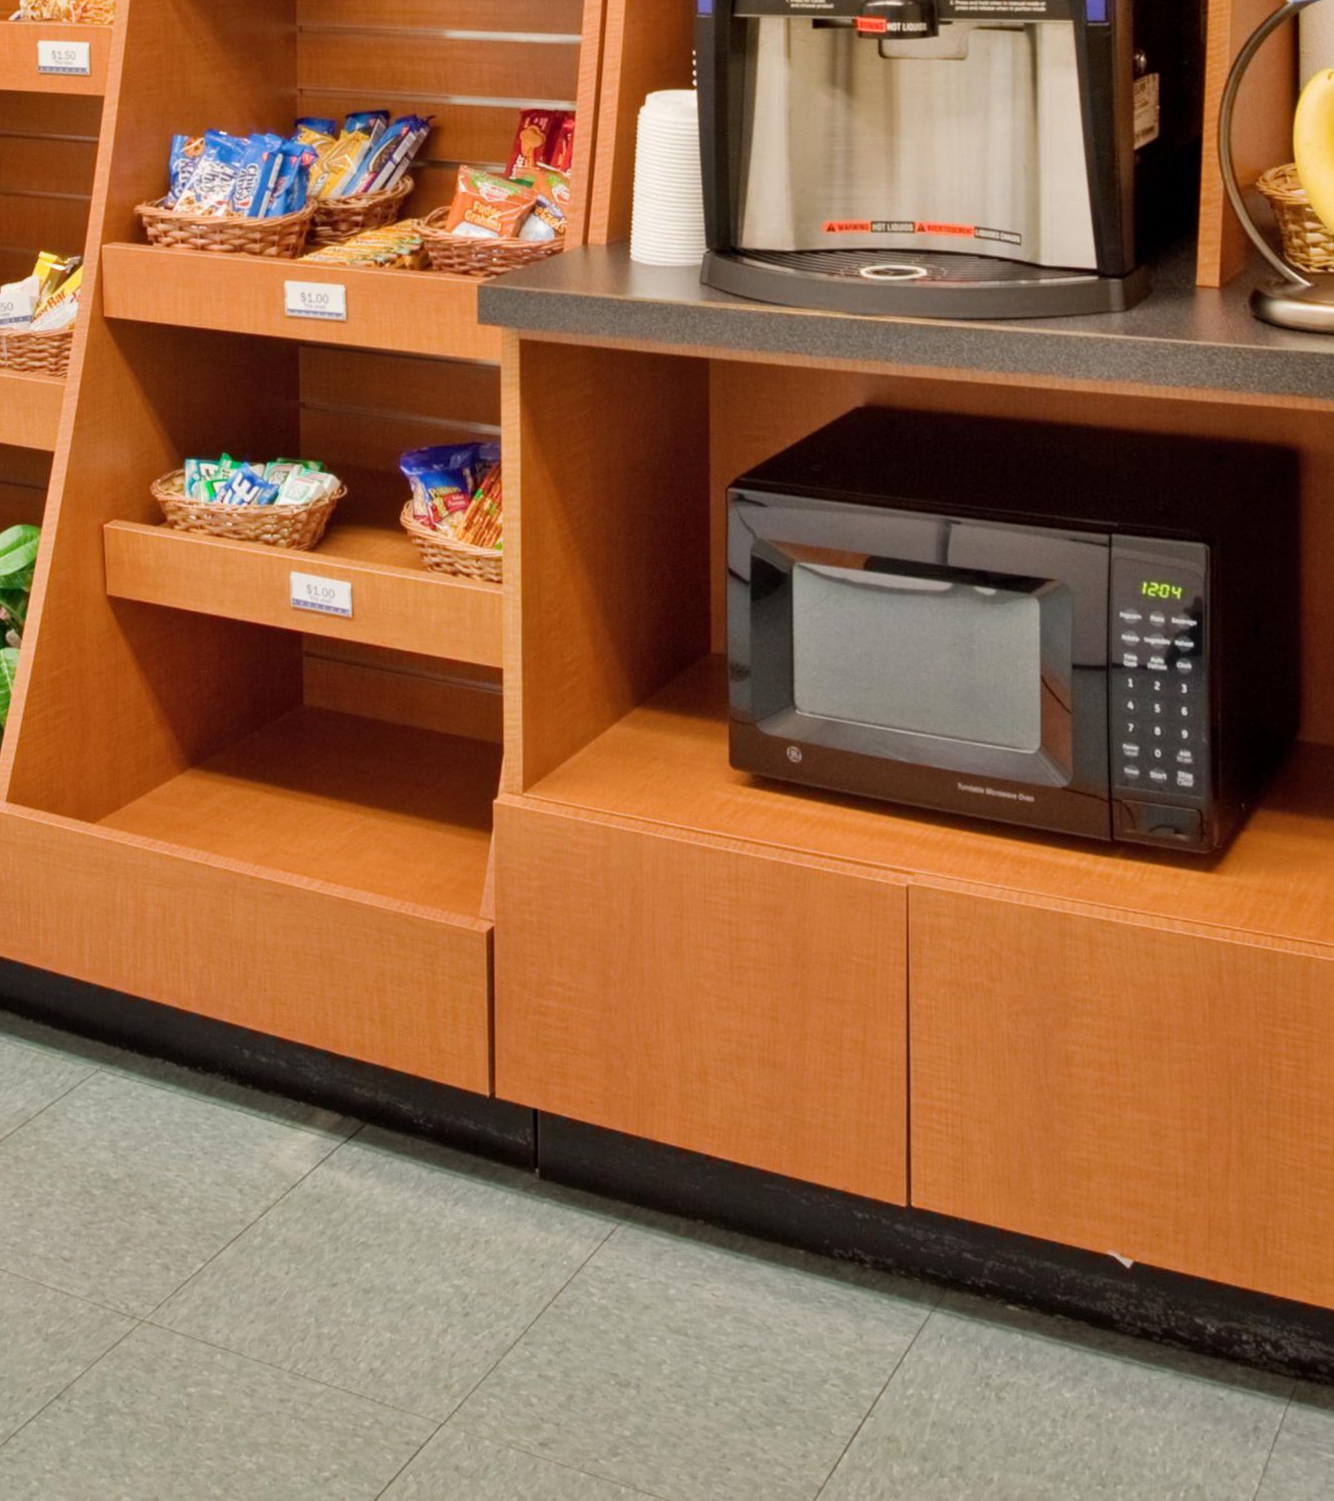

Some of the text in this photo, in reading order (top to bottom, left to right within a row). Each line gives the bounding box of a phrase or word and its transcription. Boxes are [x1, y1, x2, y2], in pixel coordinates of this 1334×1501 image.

[886, 22, 901, 31] HOT
[51, 48, 77, 61] $1.50
[472, 200, 502, 217] Fudge
[464, 209, 502, 232] Grahams
[837, 223, 870, 232] WARNING
[873, 222, 886, 232] HOT
[888, 222, 914, 232] LIQUIDS
[300, 291, 329, 304] $1.00
[306, 583, 336, 599] $1.00
[1128, 677, 1188, 694] 1 2 3
[1126, 700, 1189, 717] 4 5 6
[1127, 722, 1189, 740] 7 8 9
[1153, 748, 1162, 759] 0
[1149, 770, 1168, 781] Start
[957, 781, 1035, 803] Turntable Microwave Oven
